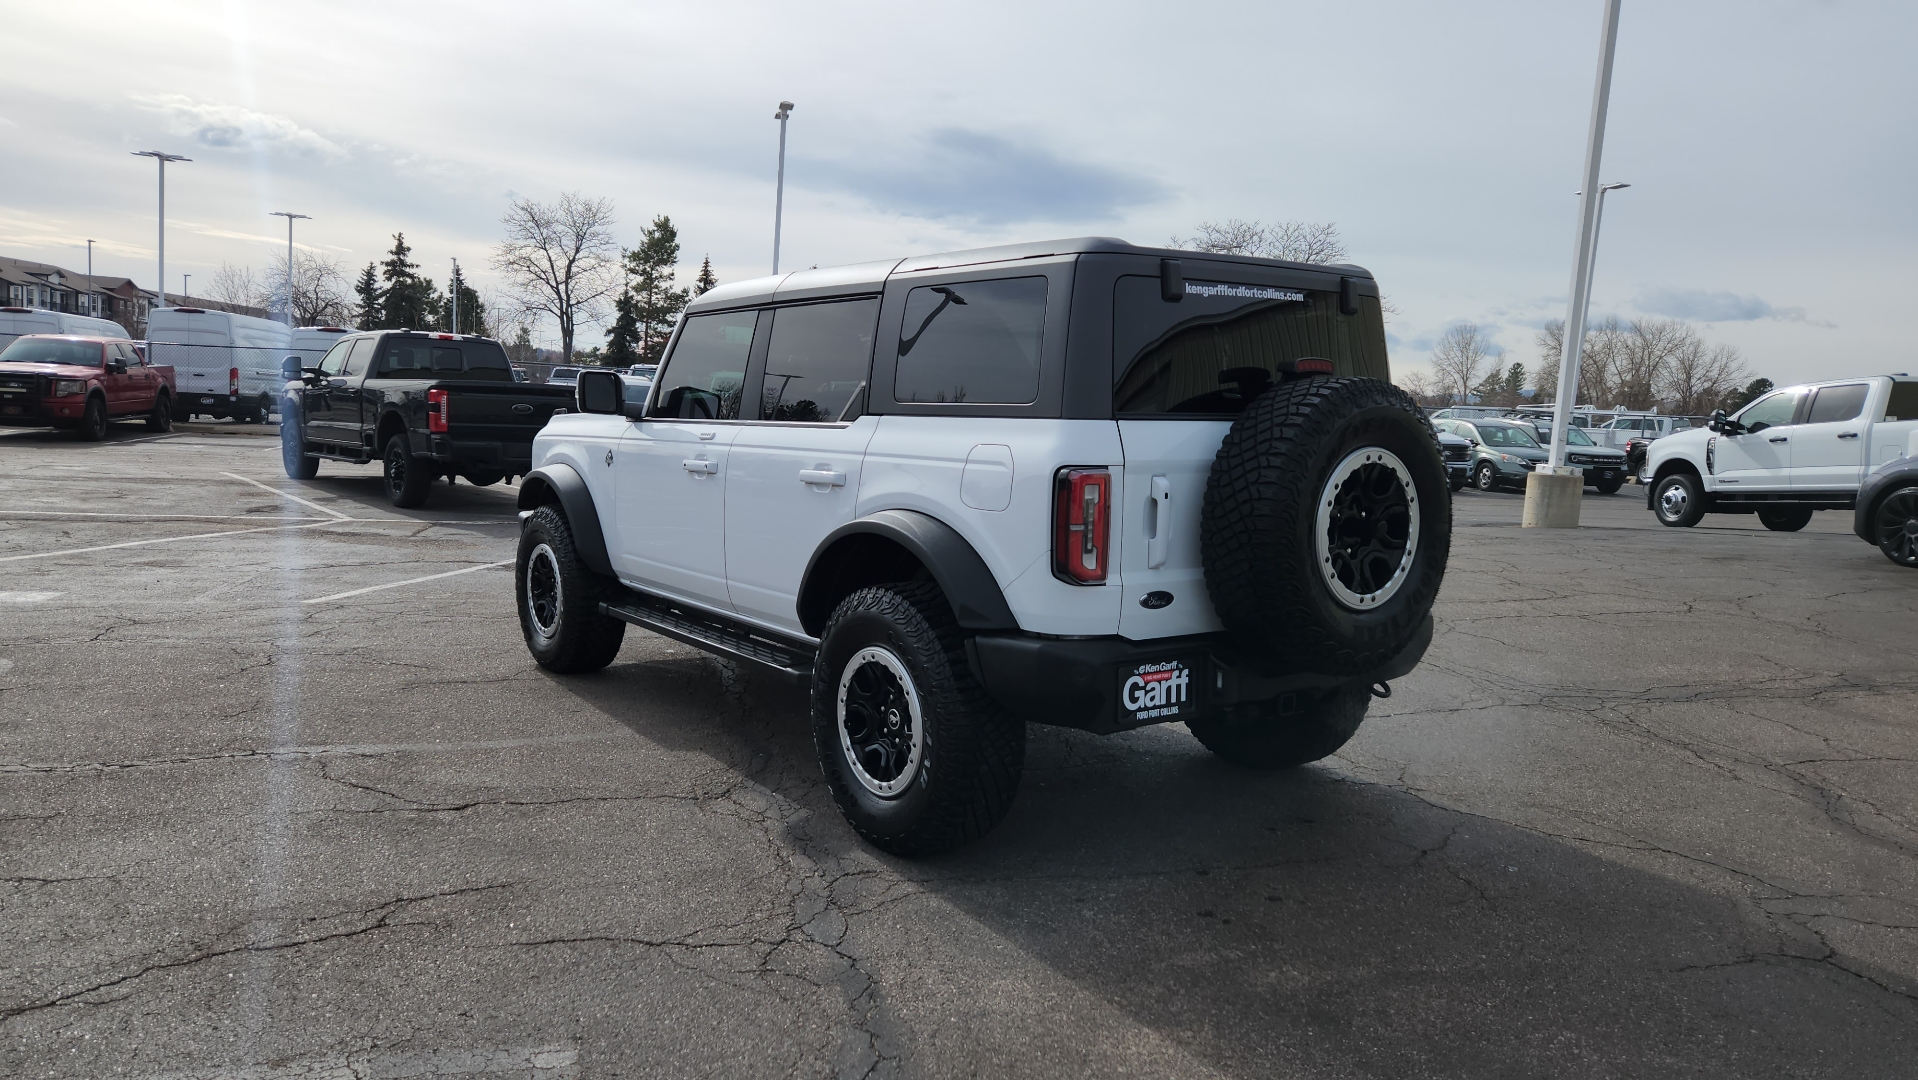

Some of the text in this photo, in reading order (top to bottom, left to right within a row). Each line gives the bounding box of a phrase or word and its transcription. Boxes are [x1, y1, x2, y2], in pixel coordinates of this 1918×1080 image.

[1185, 283, 1304, 301] kengarfffordfortcollins.com
[1145, 661, 1178, 673] Ken Garff
[1123, 669, 1189, 711] Garff
[1136, 706, 1179, 720] FORD FORT COLLINS
